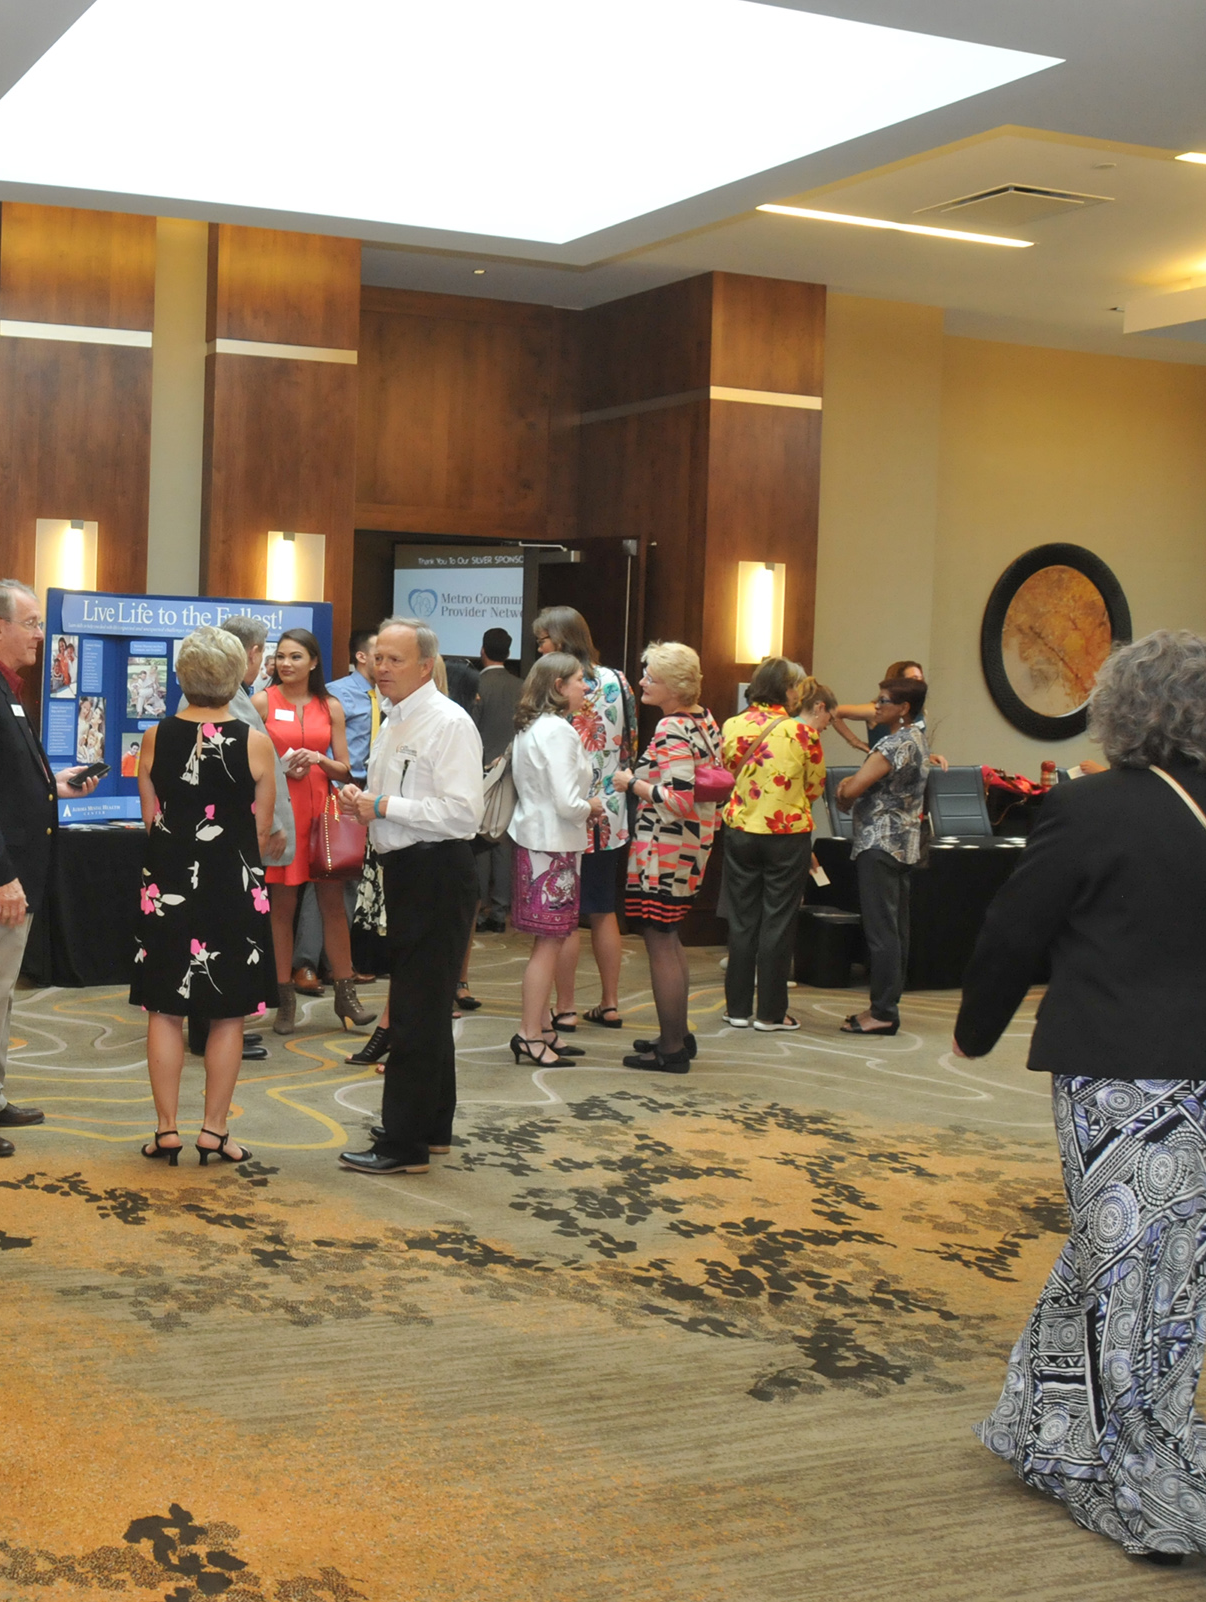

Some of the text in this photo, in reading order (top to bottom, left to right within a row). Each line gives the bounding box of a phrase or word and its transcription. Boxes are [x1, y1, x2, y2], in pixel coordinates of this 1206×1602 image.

[418, 557, 434, 565] Thank
[436, 557, 447, 565] You
[457, 556, 469, 565] Our
[471, 555, 492, 564] SILVER
[441, 593, 473, 605] Metro
[83, 600, 115, 622] Live
[118, 602, 153, 624] Life
[158, 607, 177, 625] to
[182, 605, 211, 626] the
[441, 606, 487, 618] Provider
